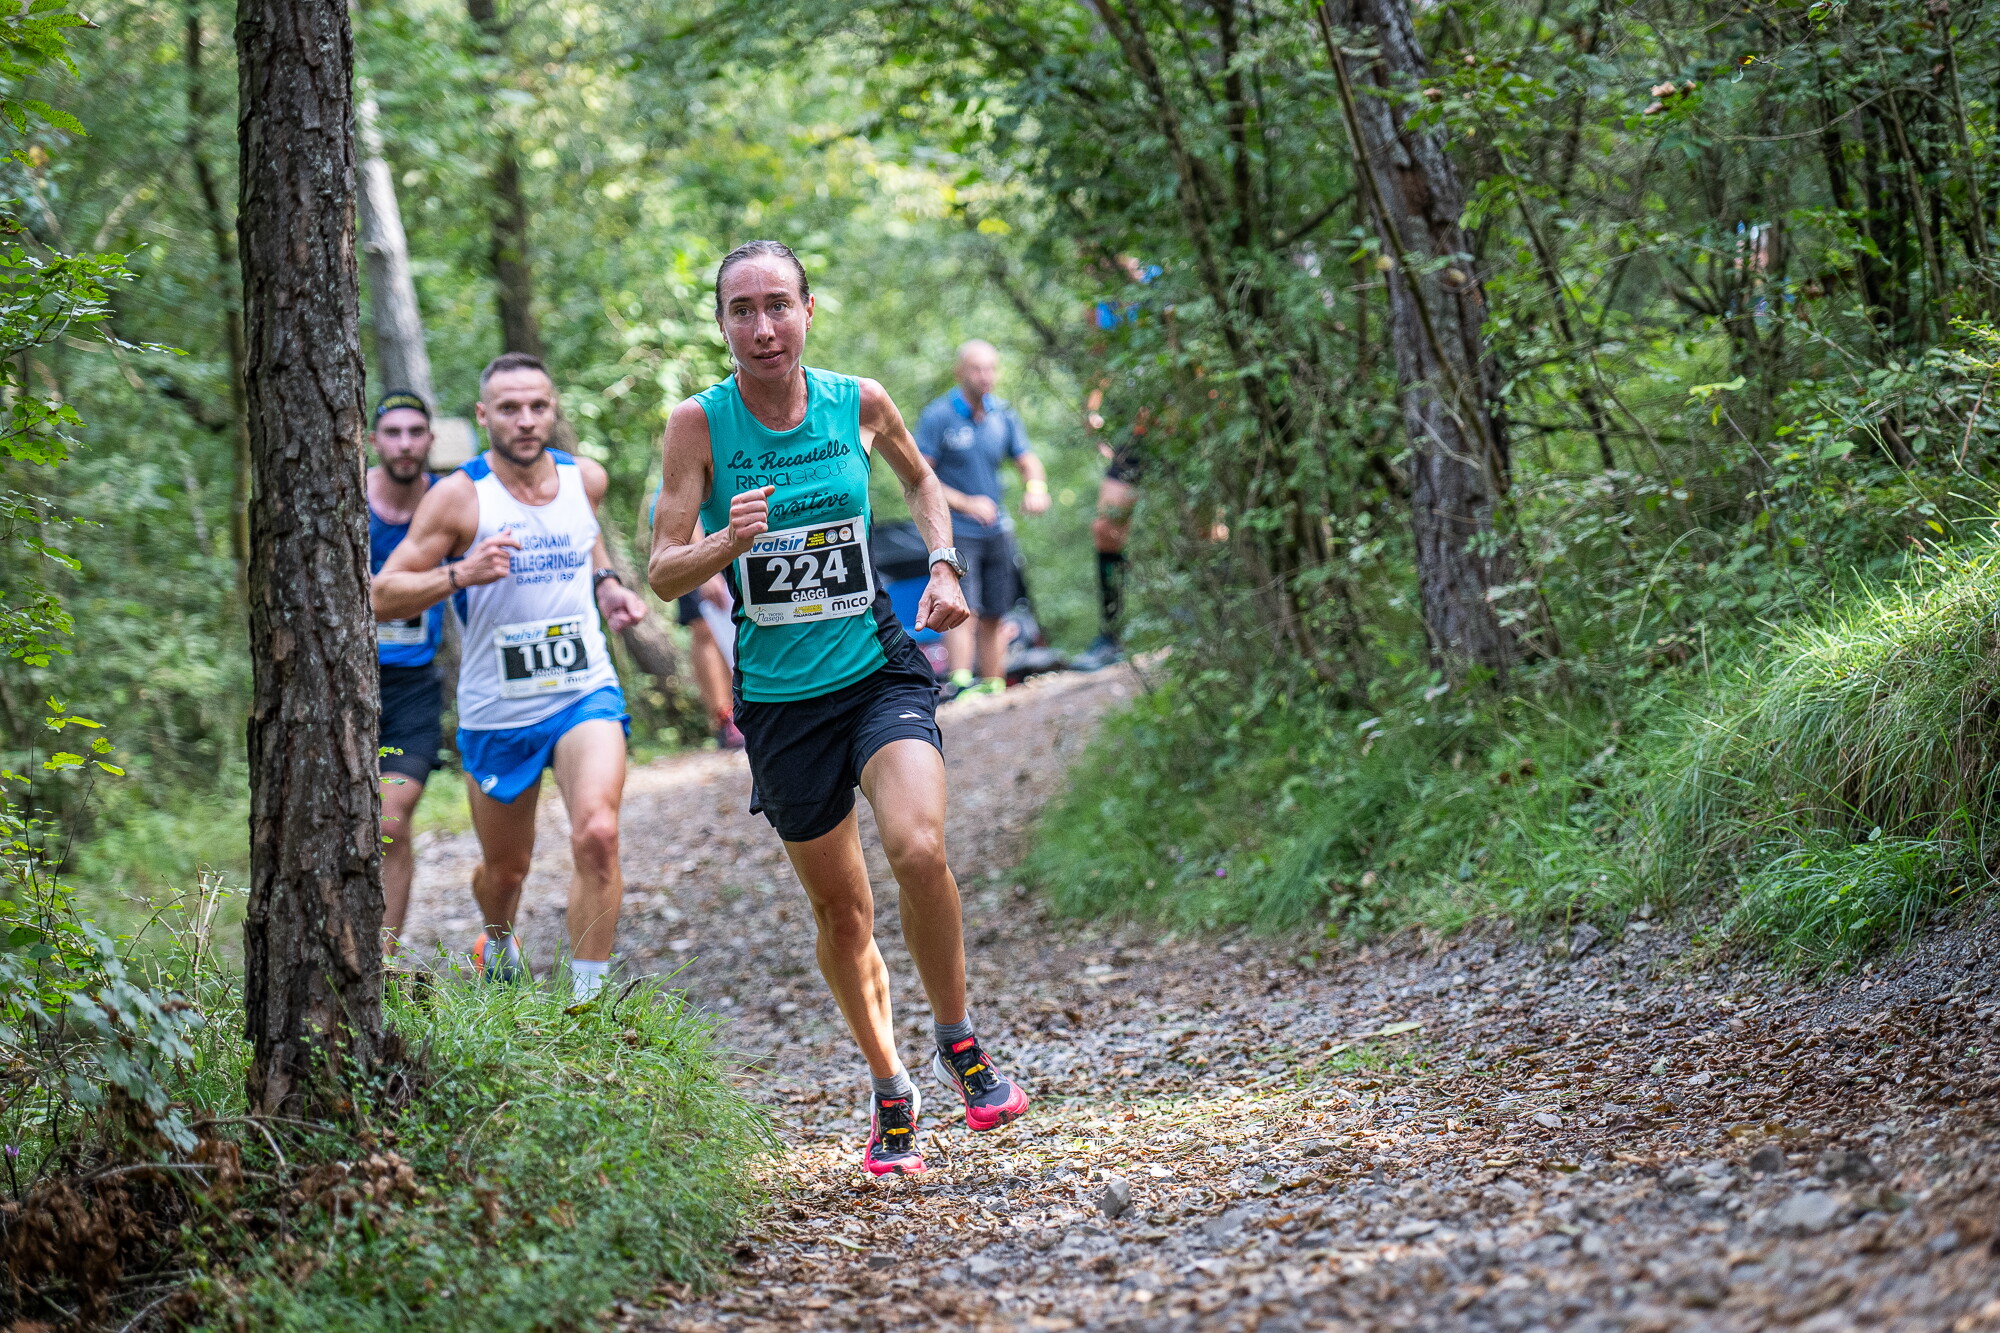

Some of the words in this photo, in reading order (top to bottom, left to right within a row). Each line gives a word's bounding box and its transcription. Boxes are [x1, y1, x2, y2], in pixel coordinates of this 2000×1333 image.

[728, 450, 753, 469] La
[757, 439, 850, 471] Recastello
[768, 492, 849, 517] nsitive
[752, 535, 804, 553] valsir
[766, 550, 848, 592] 224
[791, 588, 829, 602] GAGGI
[518, 639, 577, 672] 110
